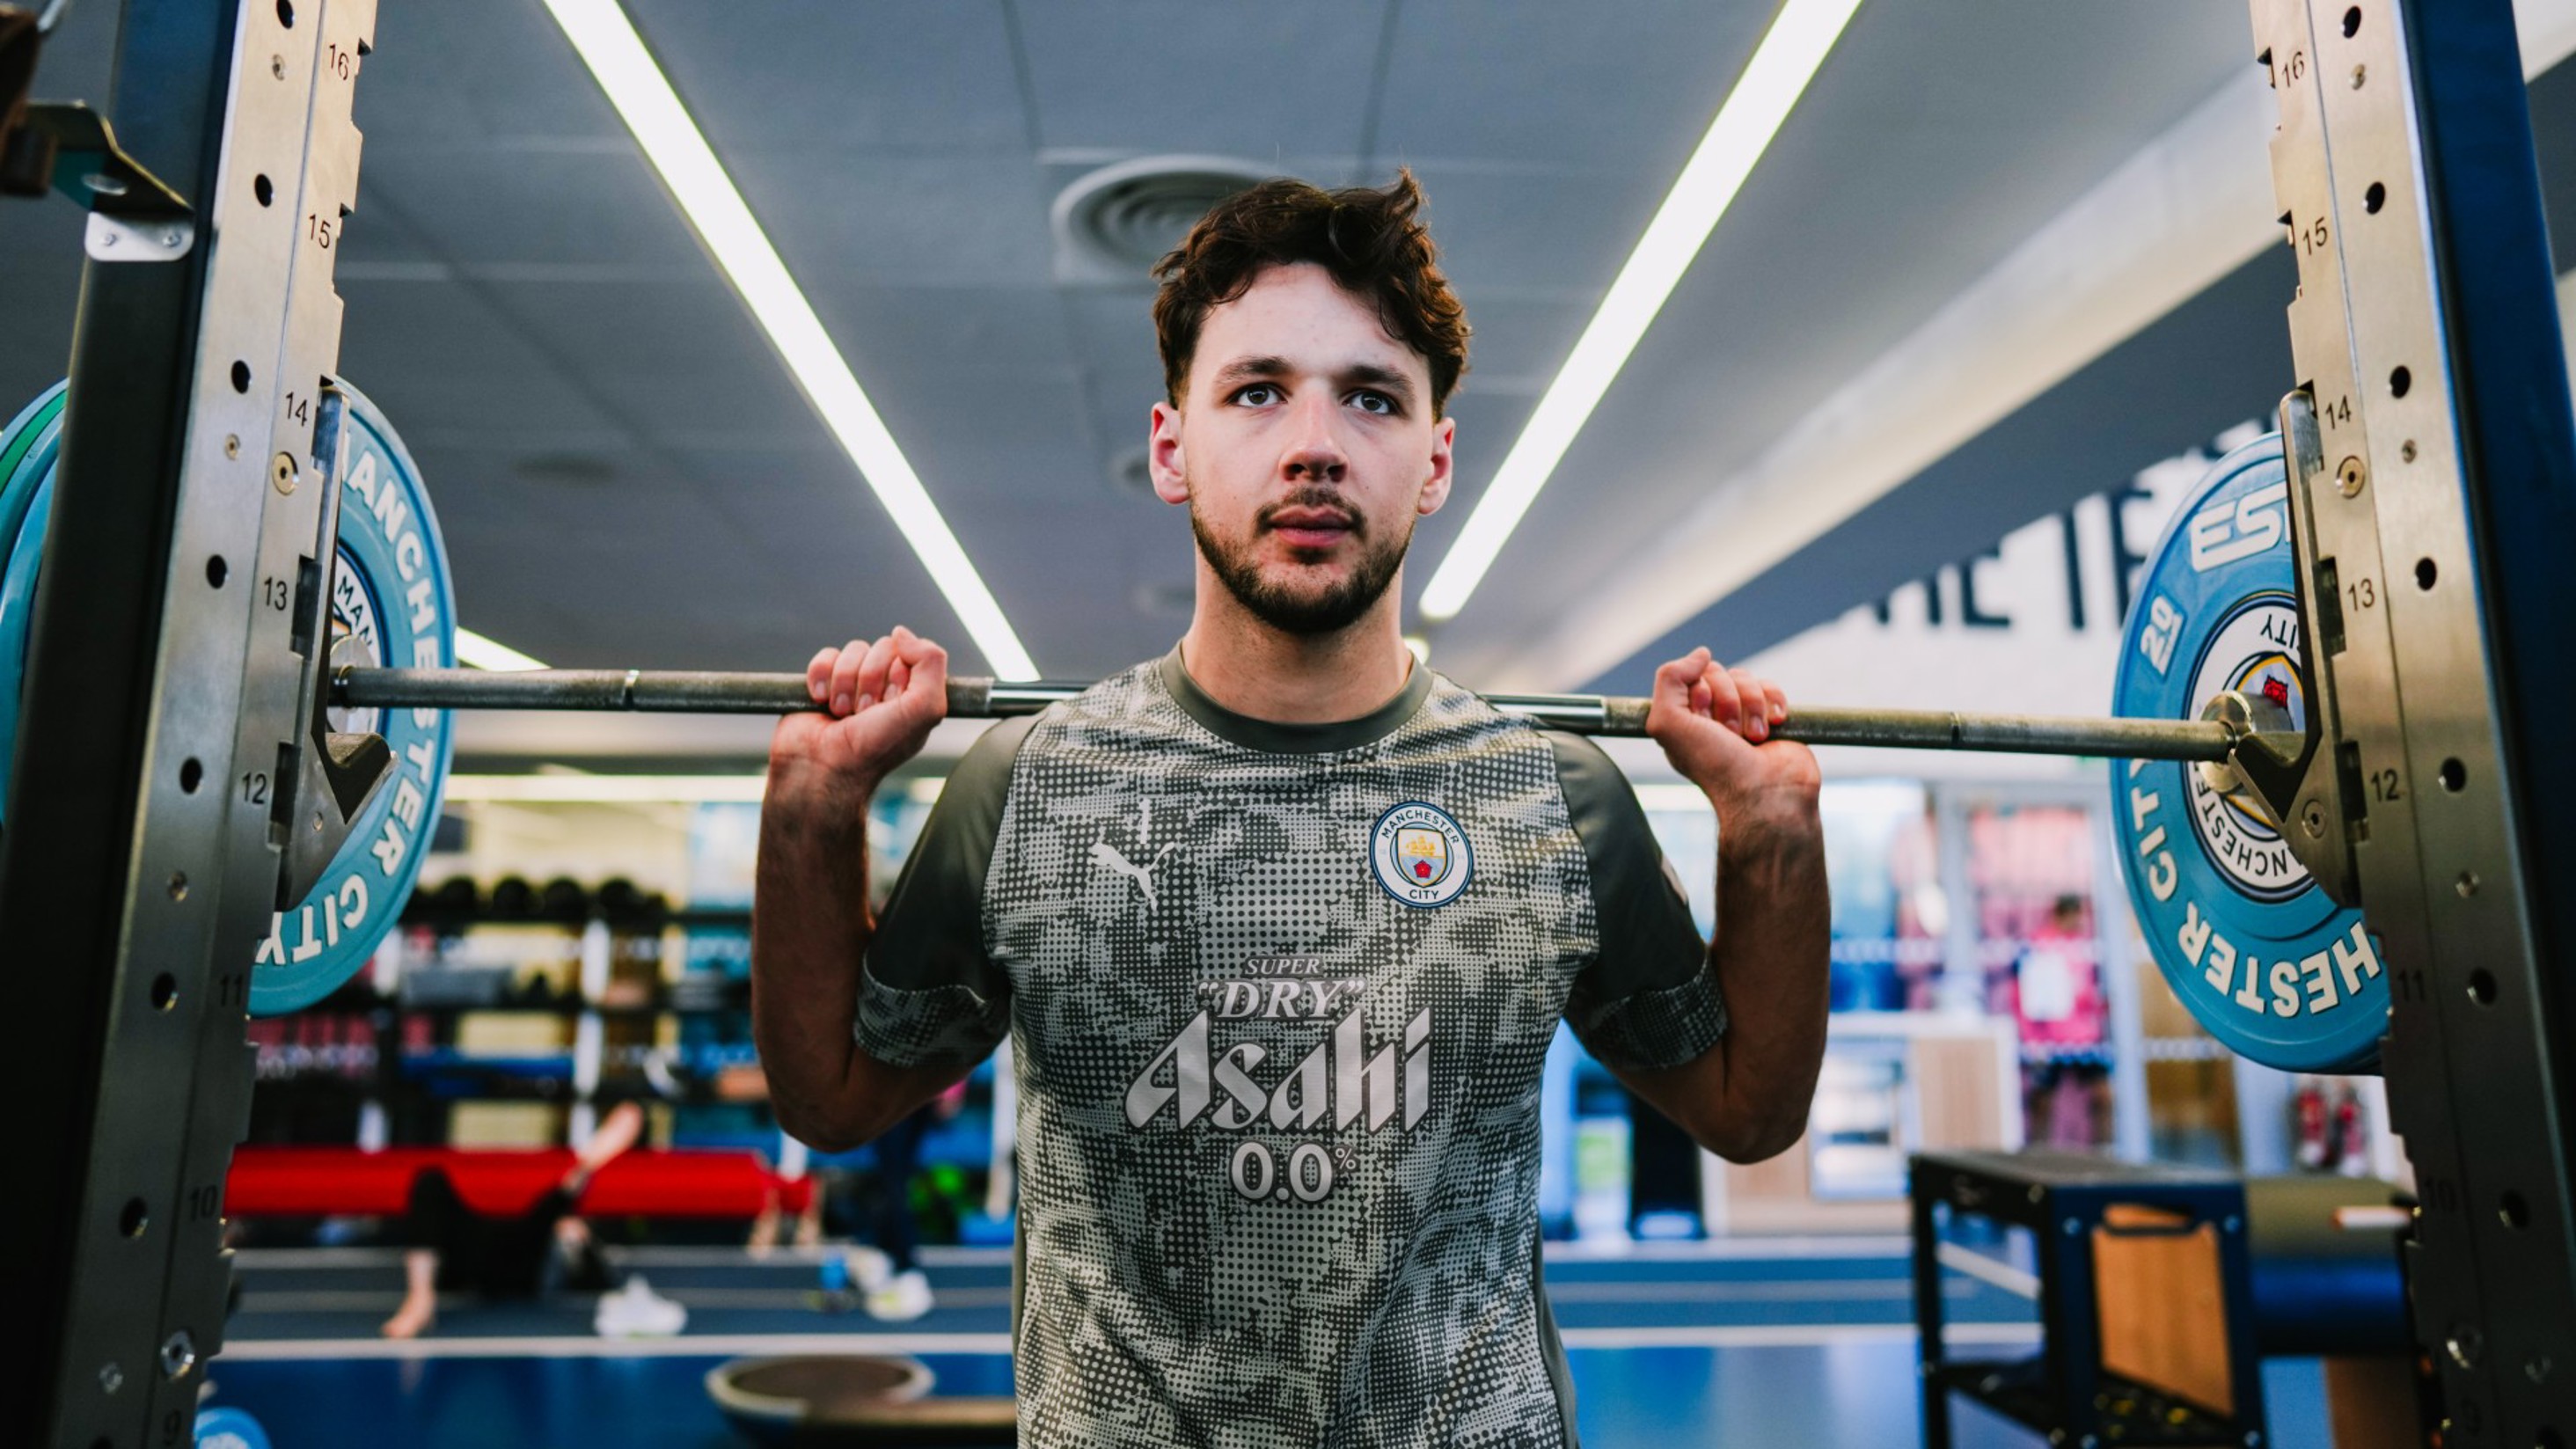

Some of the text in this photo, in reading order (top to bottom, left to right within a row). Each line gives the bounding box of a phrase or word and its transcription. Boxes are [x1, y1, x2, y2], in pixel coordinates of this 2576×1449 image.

[328, 43, 349, 80] 16
[2281, 52, 2305, 87] 16
[308, 215, 331, 250] 15
[2302, 216, 2329, 256] 15
[285, 392, 308, 428] 14
[2324, 395, 2352, 429] 14
[2191, 481, 2292, 573] ES
[264, 576, 288, 611] 13
[2347, 578, 2376, 611] 13
[2140, 595, 2179, 675] 20
[2259, 612, 2301, 653] ITY
[255, 429, 439, 965] ANCHETER CITY
[240, 771, 267, 804] 12
[2371, 768, 2399, 802] 12
[1380, 809, 1460, 845] MANCHESTER
[1409, 889, 1439, 899] CITY
[1244, 958, 1321, 976] SUPER
[2177, 920, 2381, 1019] HESTER
[217, 974, 243, 1007] 11
[2397, 969, 2426, 1002] 11
[1126, 1007, 1431, 1131] Asahi
[188, 1185, 217, 1221] 10
[2425, 1177, 2457, 1213] 10
[164, 1410, 183, 1446] 9
